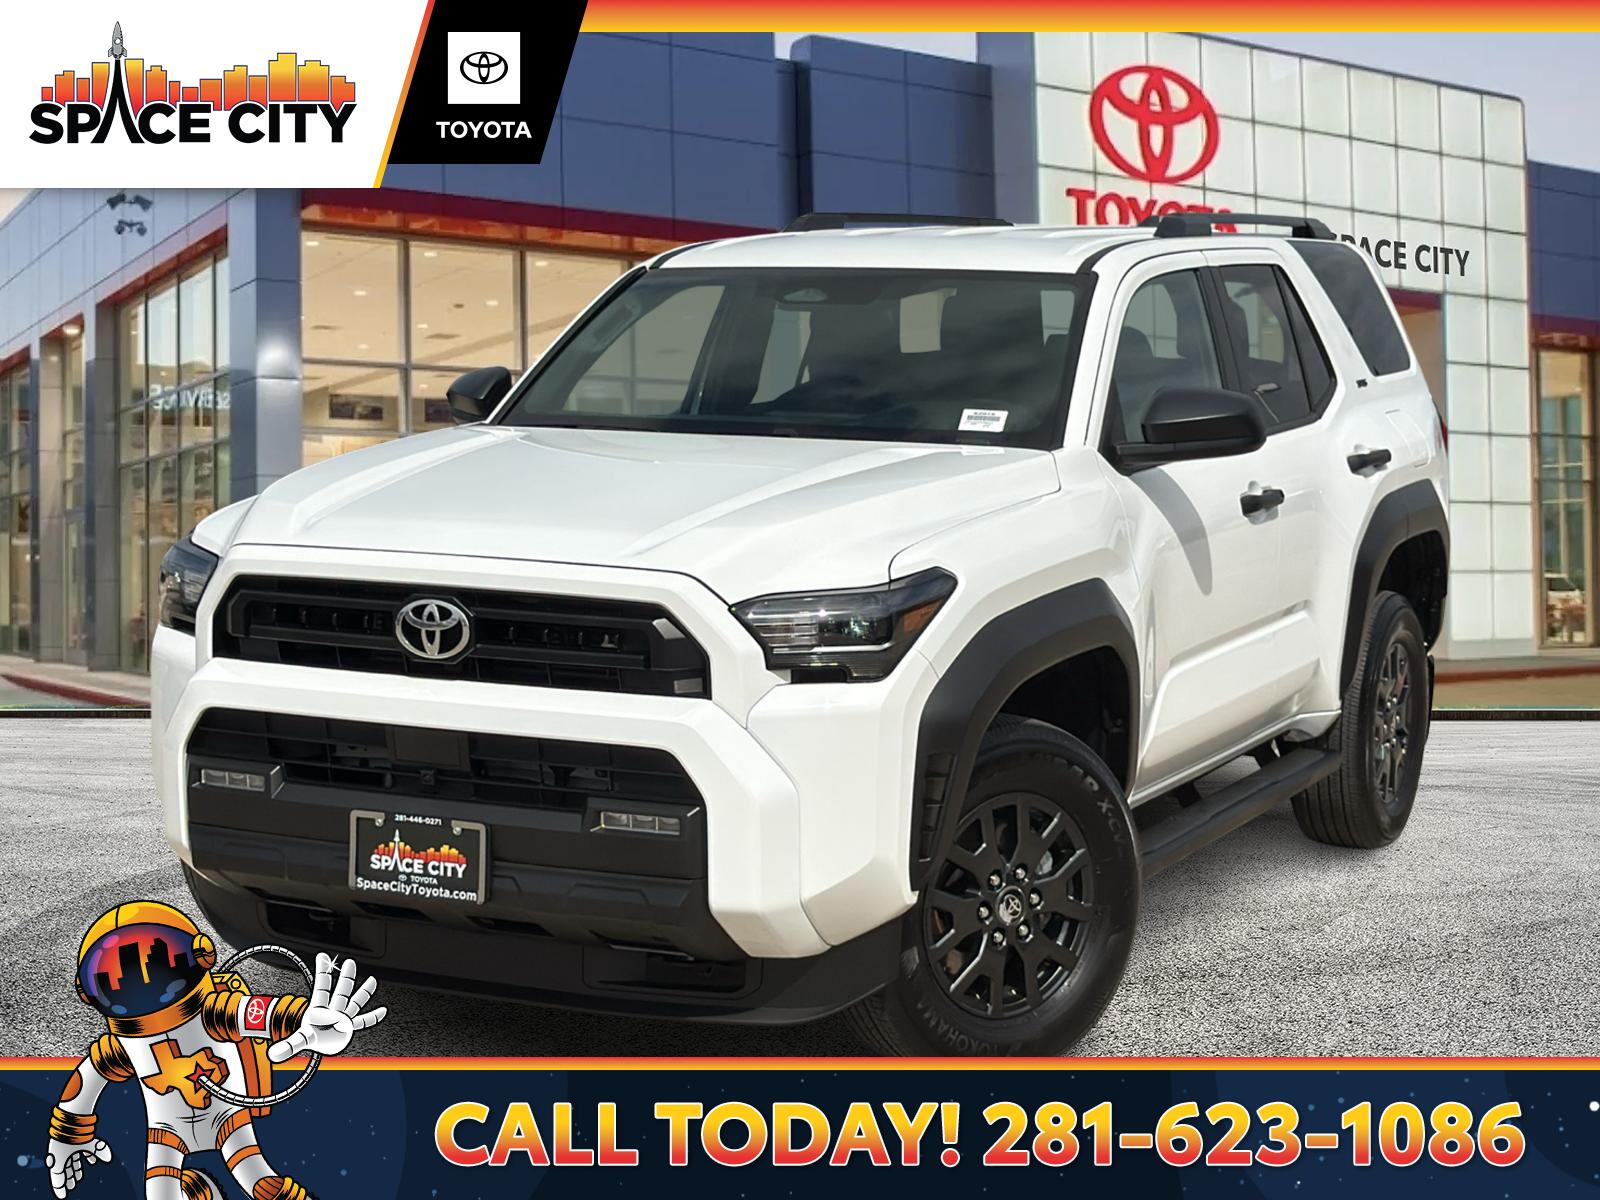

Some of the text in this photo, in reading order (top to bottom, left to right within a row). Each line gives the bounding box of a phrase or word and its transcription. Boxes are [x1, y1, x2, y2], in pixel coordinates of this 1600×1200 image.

[1066, 188, 1237, 233] TOY
[1414, 244, 1470, 276] CITY
[370, 841, 467, 879] SPACE CITY
[356, 877, 477, 901] SpaceCityToyota.com
[410, 875, 438, 885] TOYOTA
